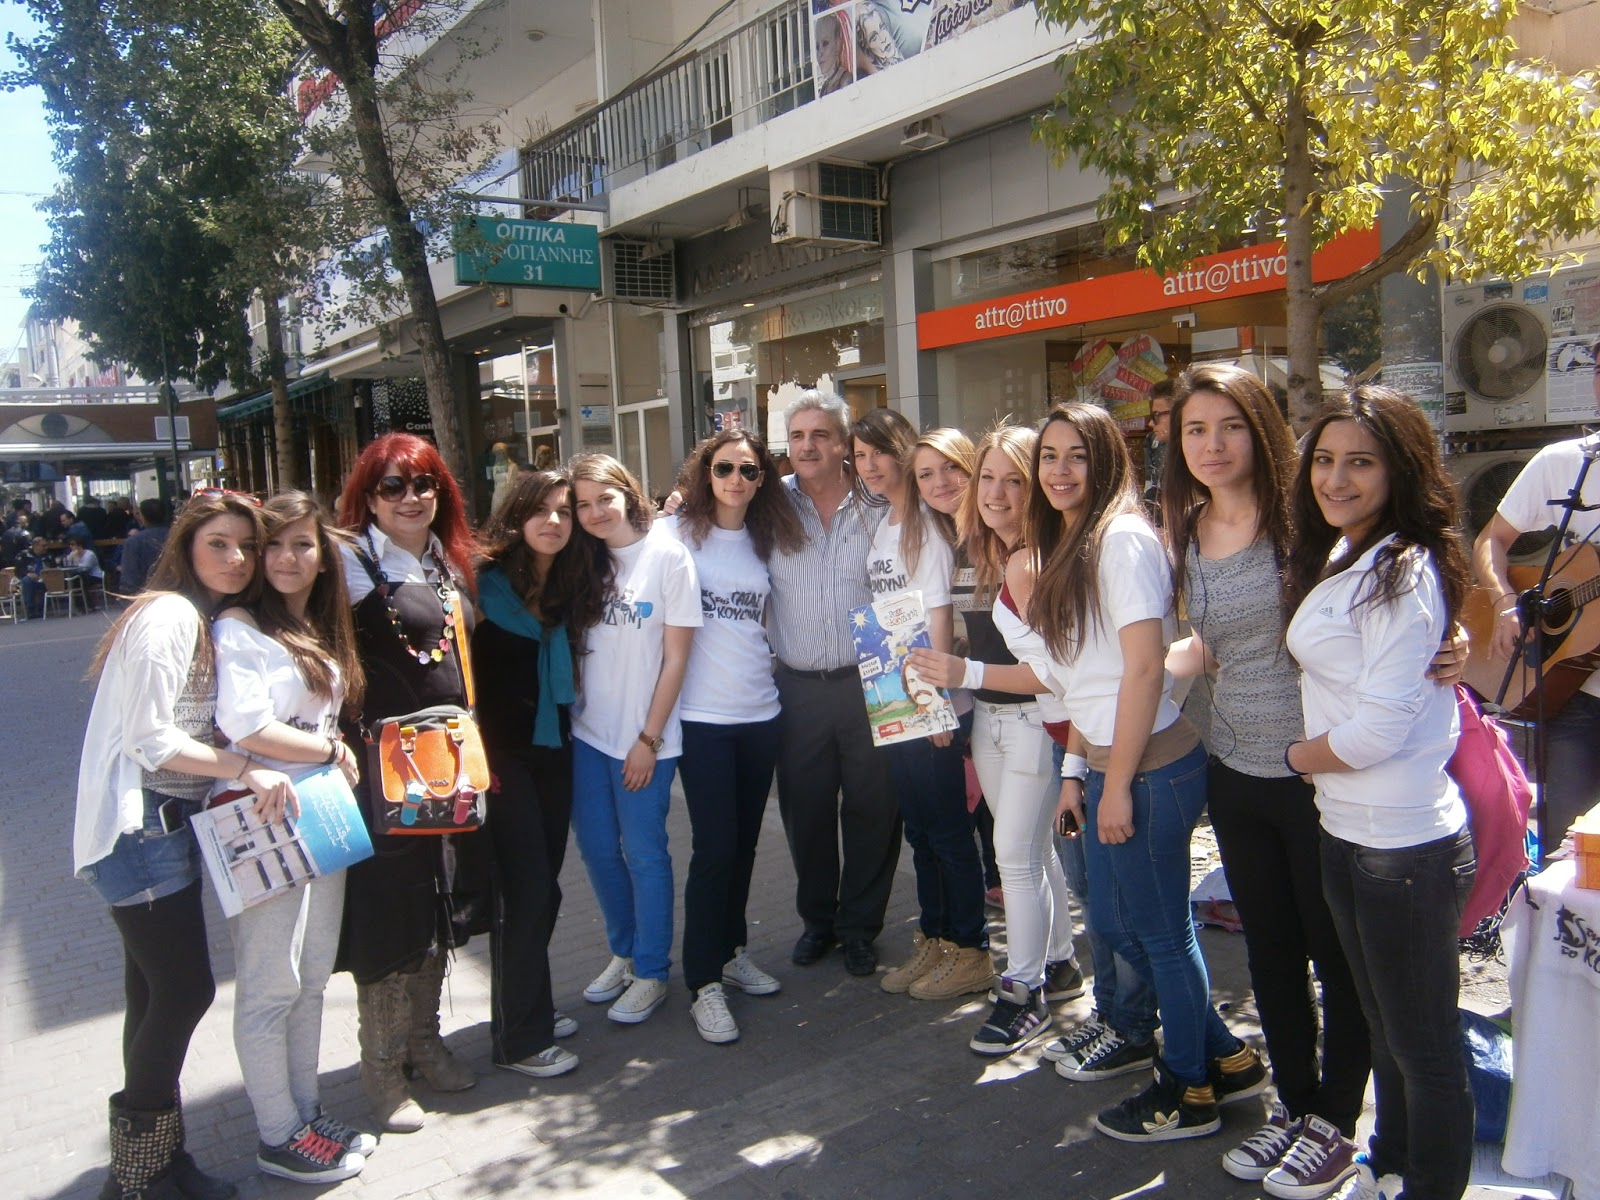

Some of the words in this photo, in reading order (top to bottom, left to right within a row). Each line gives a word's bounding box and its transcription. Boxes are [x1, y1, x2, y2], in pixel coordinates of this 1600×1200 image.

[496, 223, 566, 244] ΟΠΤΙΚΑ
[523, 265, 543, 281] 31
[1163, 254, 1287, 296] attr@ttivo
[975, 296, 1067, 329] attr@ttivo
